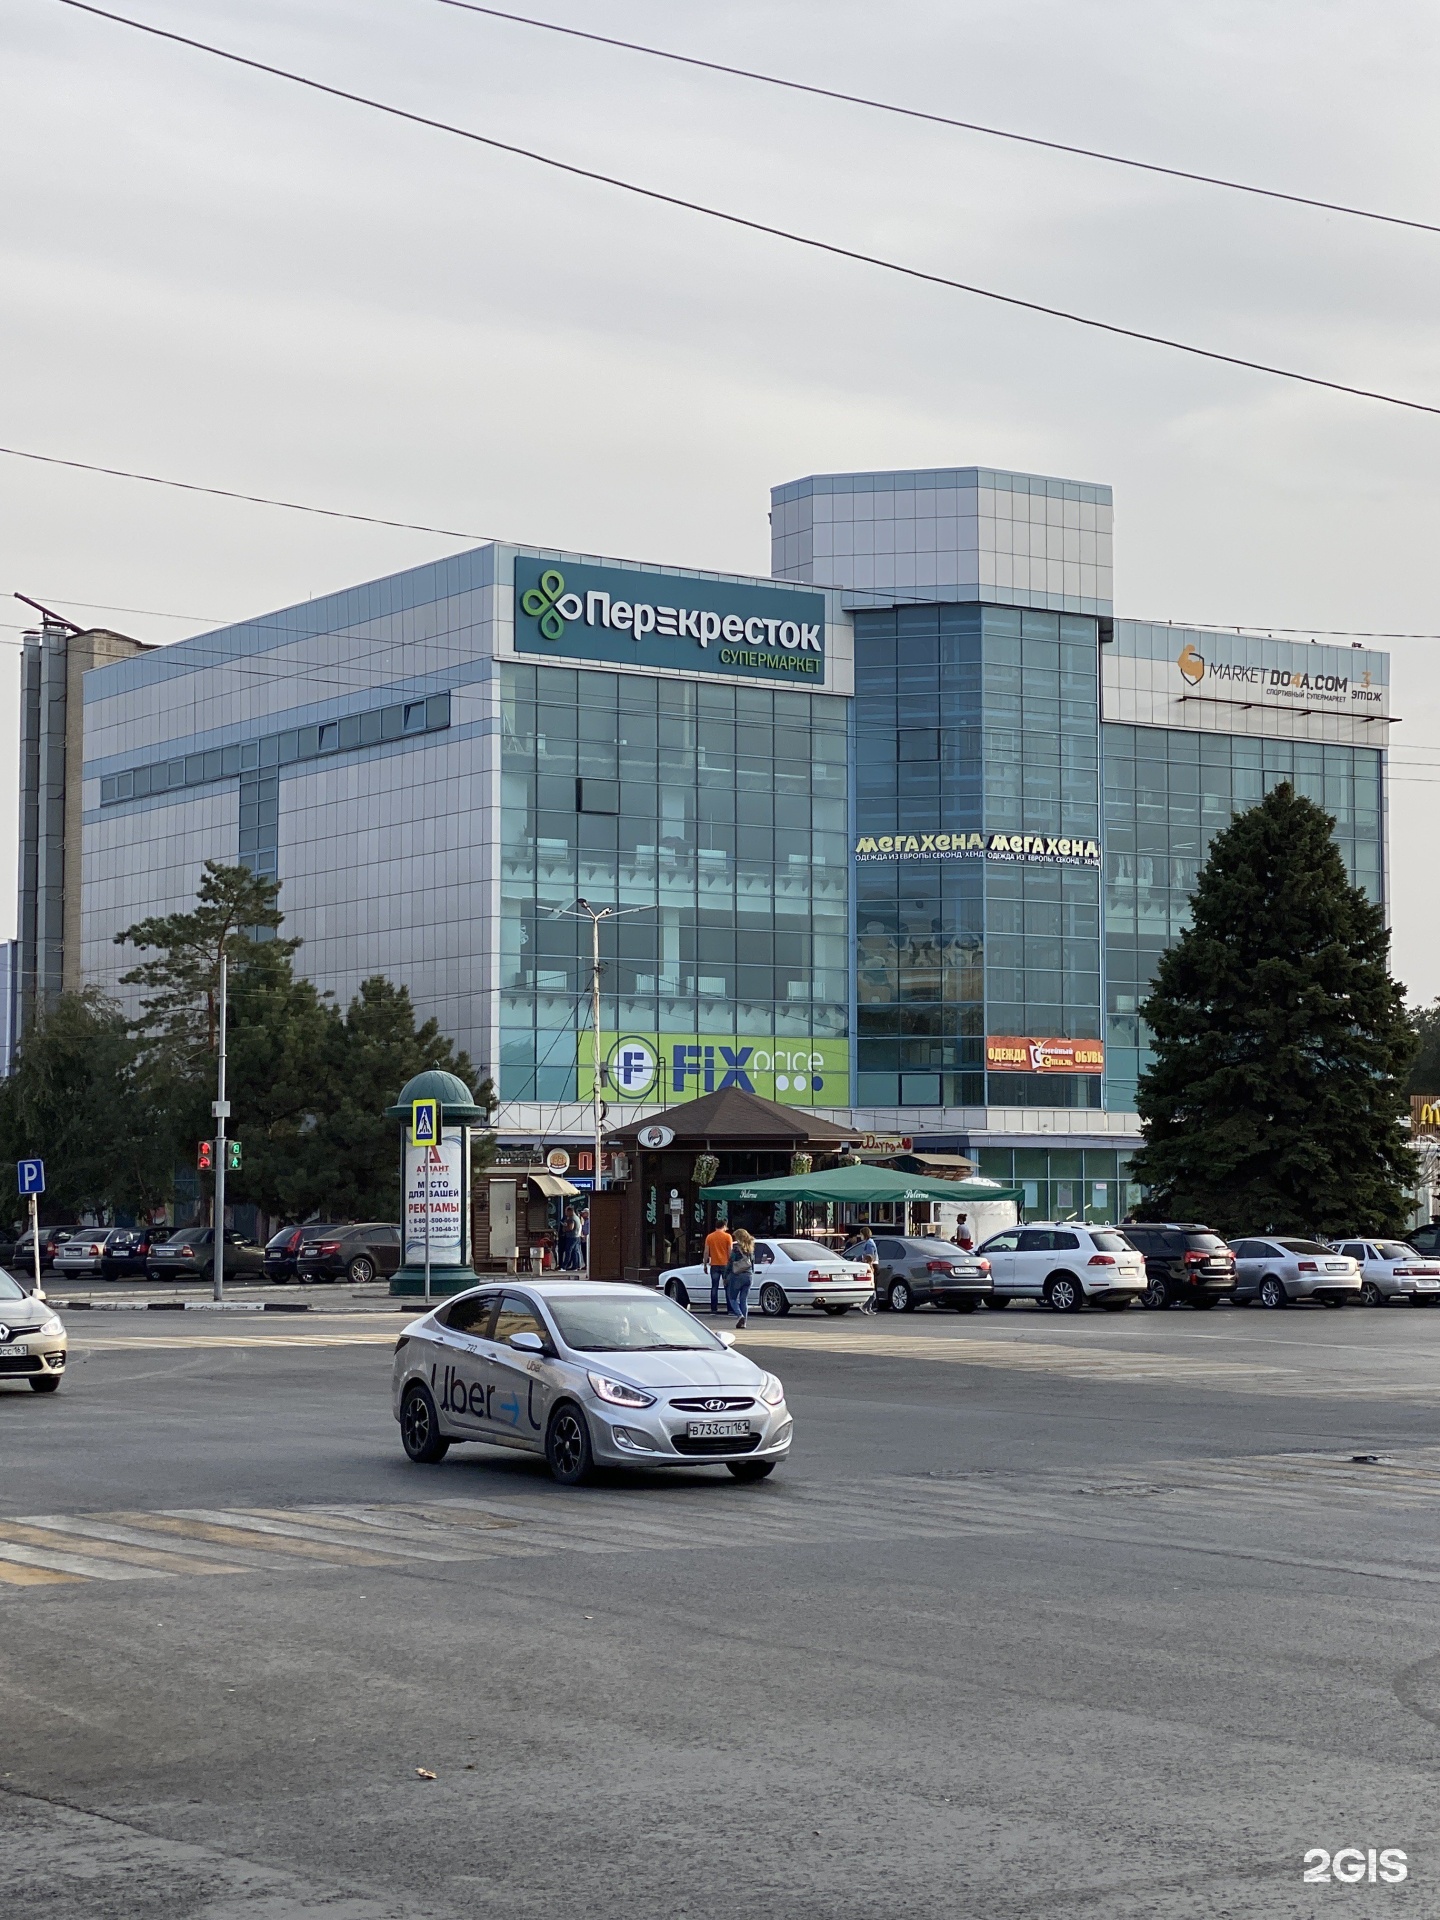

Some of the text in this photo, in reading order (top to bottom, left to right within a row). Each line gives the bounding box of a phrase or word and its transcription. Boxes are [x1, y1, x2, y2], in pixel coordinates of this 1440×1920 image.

[721, 649, 821, 673] СУПЕРМАРКЕТ
[1361, 671, 1372, 688] 3
[1266, 688, 1346, 703] СПОРТИВНЫЙ СУПЕРМАРКЕТ
[855, 853, 888, 861] ОДЕЖДА
[888, 852, 899, 860] ИЗ
[900, 851, 932, 860] ЕВРОПЫ
[987, 852, 1015, 861] ОДЕЖДА
[1027, 854, 1054, 863] ЕВРОПЫ
[988, 1047, 1027, 1062] ОДЕЖДА
[1074, 1050, 1104, 1065] ОБУВЬ
[753, 1050, 824, 1079] price
[24, 1163, 38, 1191] P
[418, 1181, 449, 1189] МСТО
[408, 1190, 425, 1199] ДЛЯ
[526, 1360, 542, 1373] Uber
[431, 1363, 496, 1419] Uber
[692, 1421, 748, 1436] В733СТ 161
